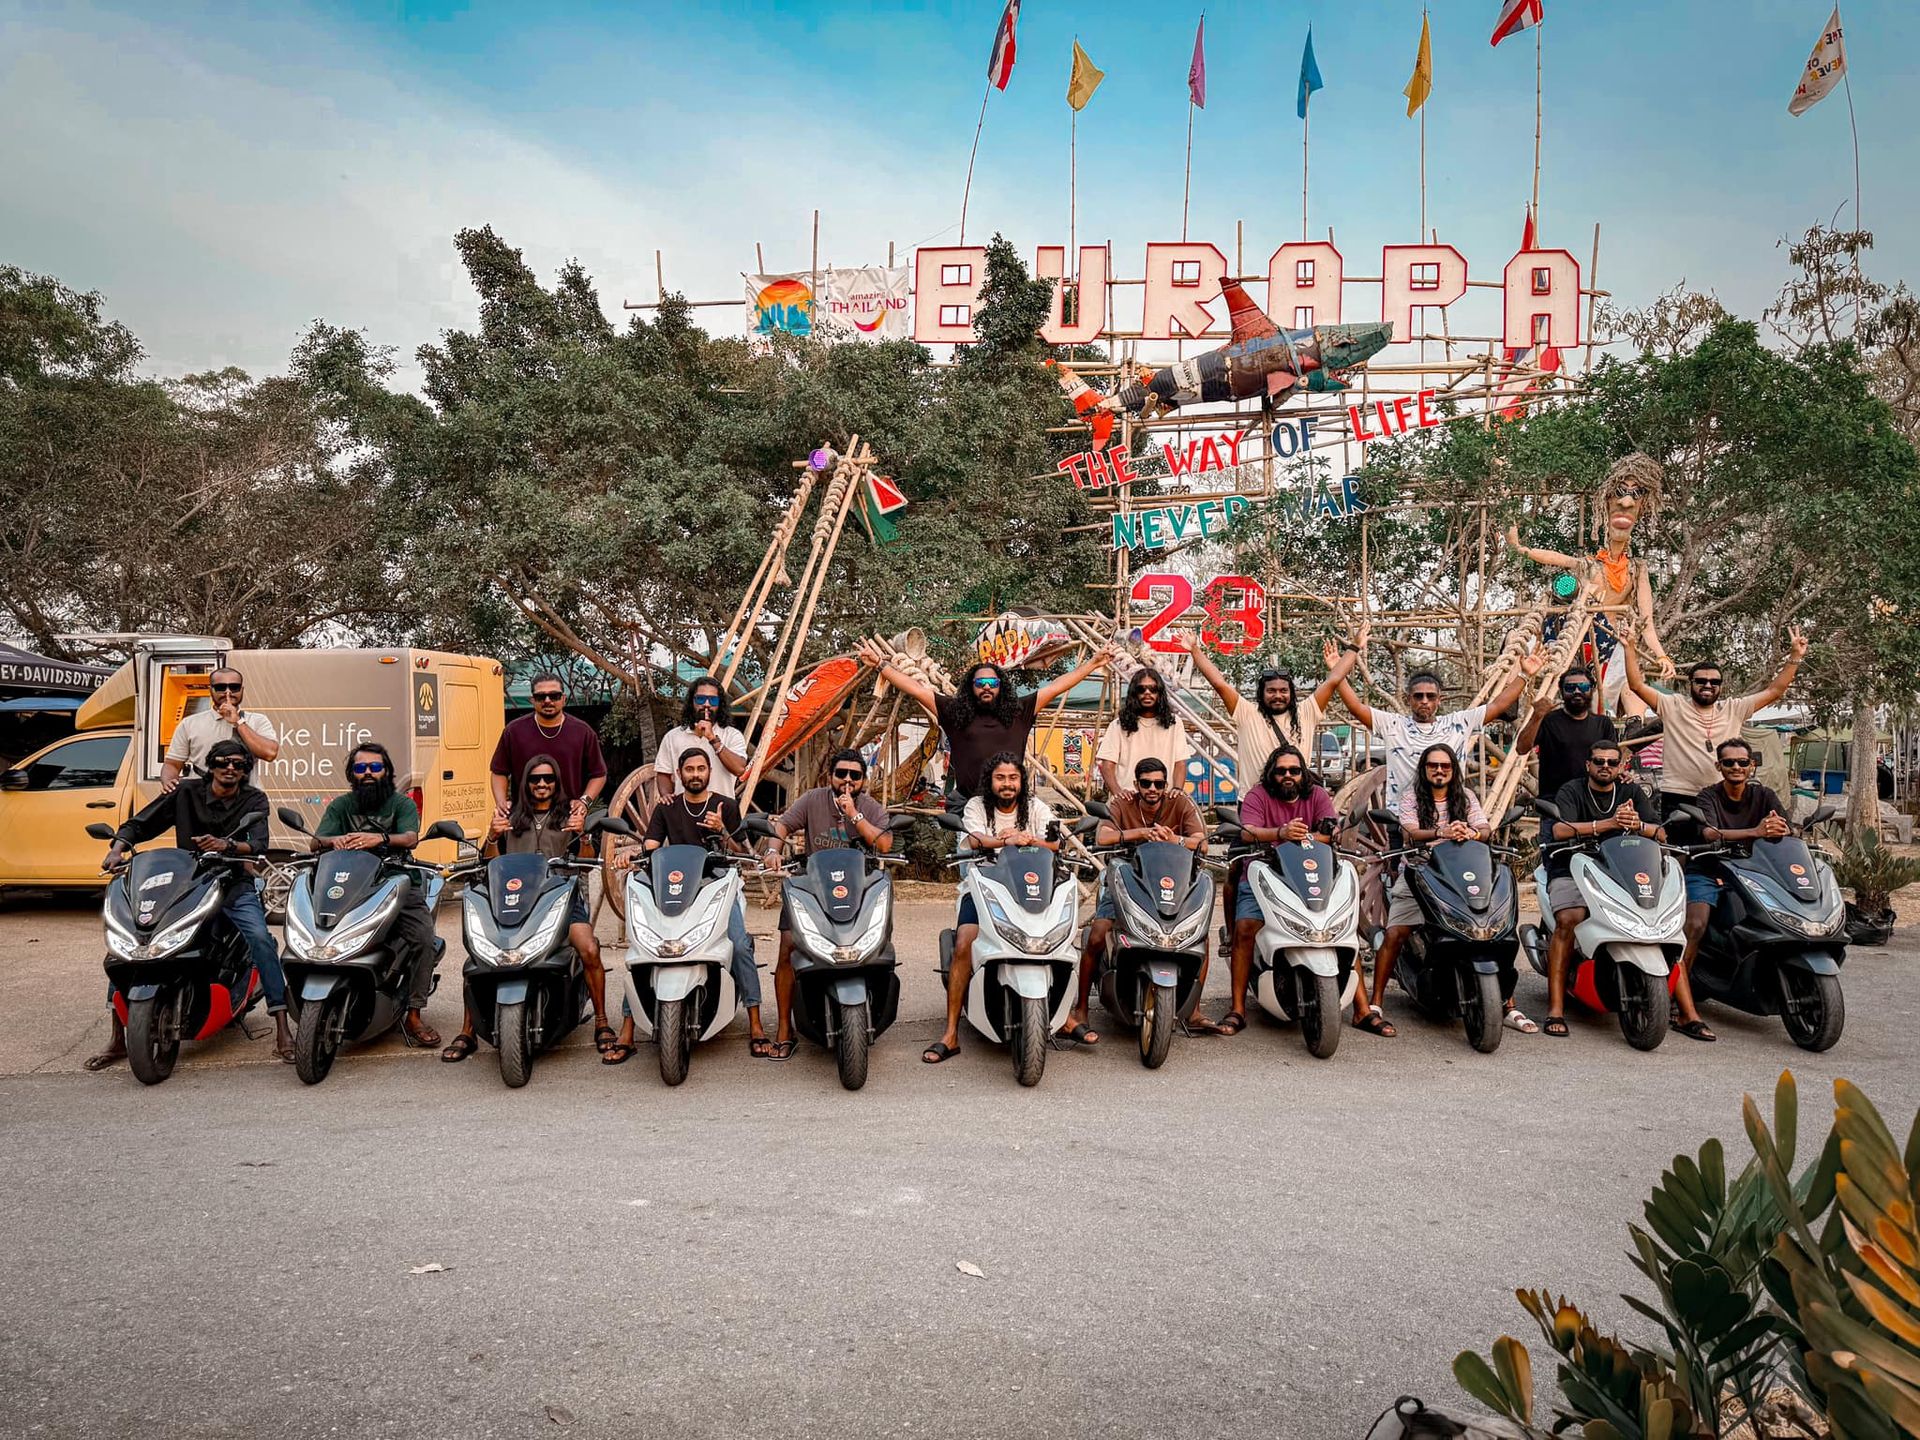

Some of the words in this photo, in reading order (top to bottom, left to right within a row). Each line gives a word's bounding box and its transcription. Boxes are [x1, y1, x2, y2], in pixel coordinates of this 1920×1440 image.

[831, 298, 907, 314] THAILAND
[915, 242, 1580, 348] BURAPA
[1057, 444, 1139, 490] THE
[1163, 430, 1246, 477] WAY
[1270, 416, 1320, 459] OF
[1347, 388, 1441, 443] LIFE
[280, 722, 310, 746] ke
[322, 722, 372, 752] Life
[257, 752, 333, 782] imple
[814, 836, 850, 849] adida
